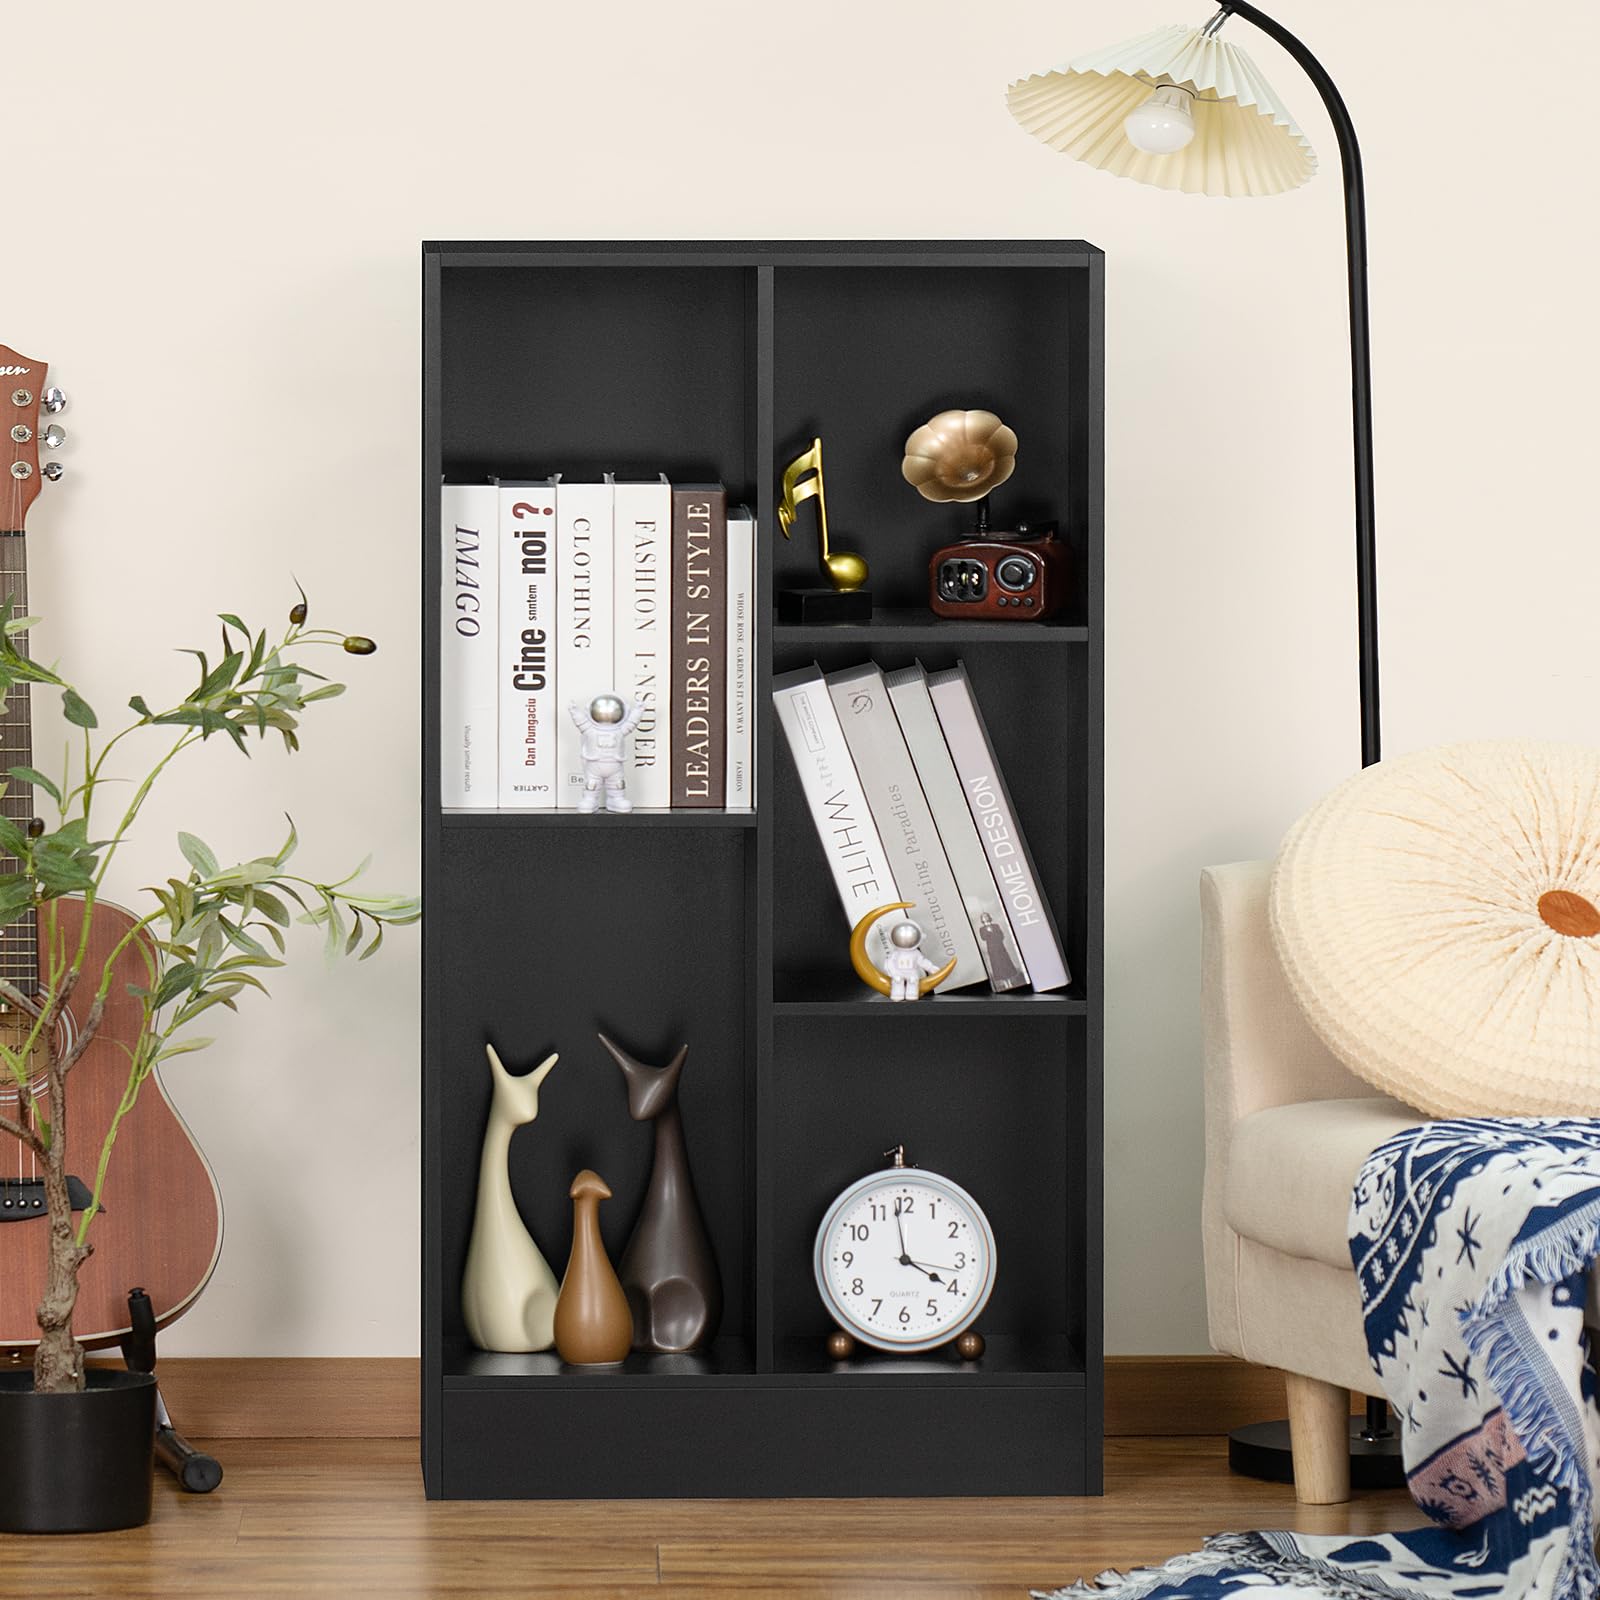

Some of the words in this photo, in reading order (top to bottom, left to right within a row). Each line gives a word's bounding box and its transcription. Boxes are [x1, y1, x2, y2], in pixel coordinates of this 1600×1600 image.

[512, 502, 553, 519] ?
[514, 531, 546, 574] noi
[687, 502, 710, 599] STYLE
[455, 525, 480, 637] IMAGO
[573, 518, 591, 649] CLOTHING
[635, 520, 656, 631] FASHION
[527, 583, 537, 621] snntem
[736, 592, 744, 619] WHOSE
[687, 612, 710, 644] IN
[736, 620, 744, 642] ROSE
[513, 629, 546, 691] Cine
[736, 646, 744, 680] GARDEN
[525, 698, 538, 743] Dungaciu
[686, 657, 710, 797] LEADERS
[736, 701, 744, 735] ANYWAY
[525, 747, 536, 766] Dan
[888, 784, 921, 854] Paradies
[969, 776, 1015, 859] DESION
[824, 789, 880, 898] WHITE
[916, 859, 957, 957] onstructing
[1000, 861, 1039, 927] HOME
[871, 1205, 886, 1221] 11
[896, 1197, 914, 1214] 12
[929, 1203, 936, 1220] 1
[850, 1224, 870, 1241] 10
[948, 1221, 959, 1239] 2
[841, 1251, 854, 1269] 9
[954, 1252, 966, 1270] 3
[851, 1278, 864, 1296] 8
[889, 1290, 920, 1298] QUARTZ
[946, 1279, 960, 1296] 4
[871, 1299, 883, 1316] 7
[898, 1306, 911, 1324] 6
[926, 1299, 938, 1317] 5
